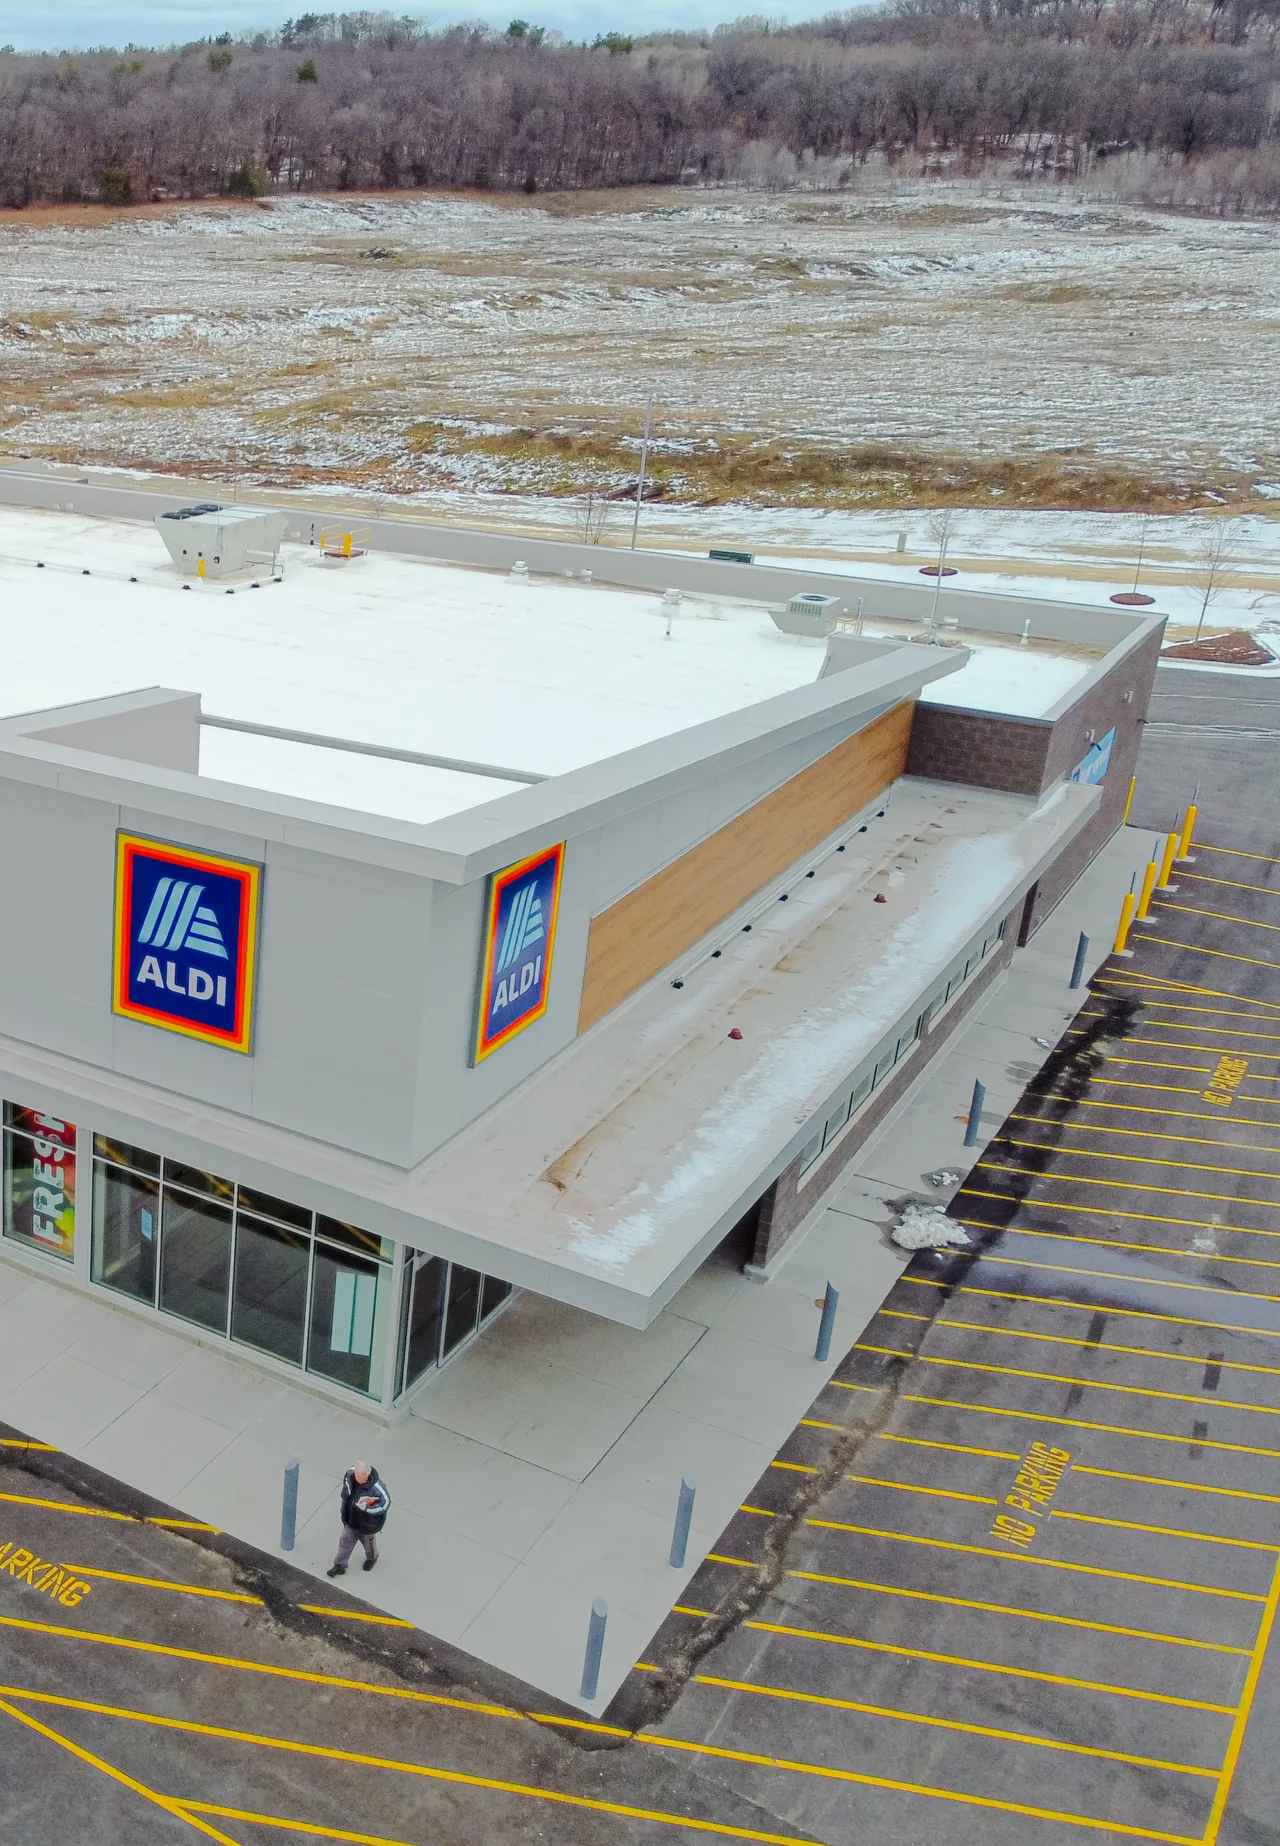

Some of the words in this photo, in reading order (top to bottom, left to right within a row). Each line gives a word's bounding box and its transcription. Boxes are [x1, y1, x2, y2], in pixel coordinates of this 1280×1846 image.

[136, 955, 227, 1007] ALDI
[492, 954, 542, 1015] ALDI
[1208, 1055, 1249, 1092] PARKING
[1201, 1090, 1233, 1108] NO
[1004, 1440, 1071, 1518] PARKING
[989, 1514, 1036, 1549] NO
